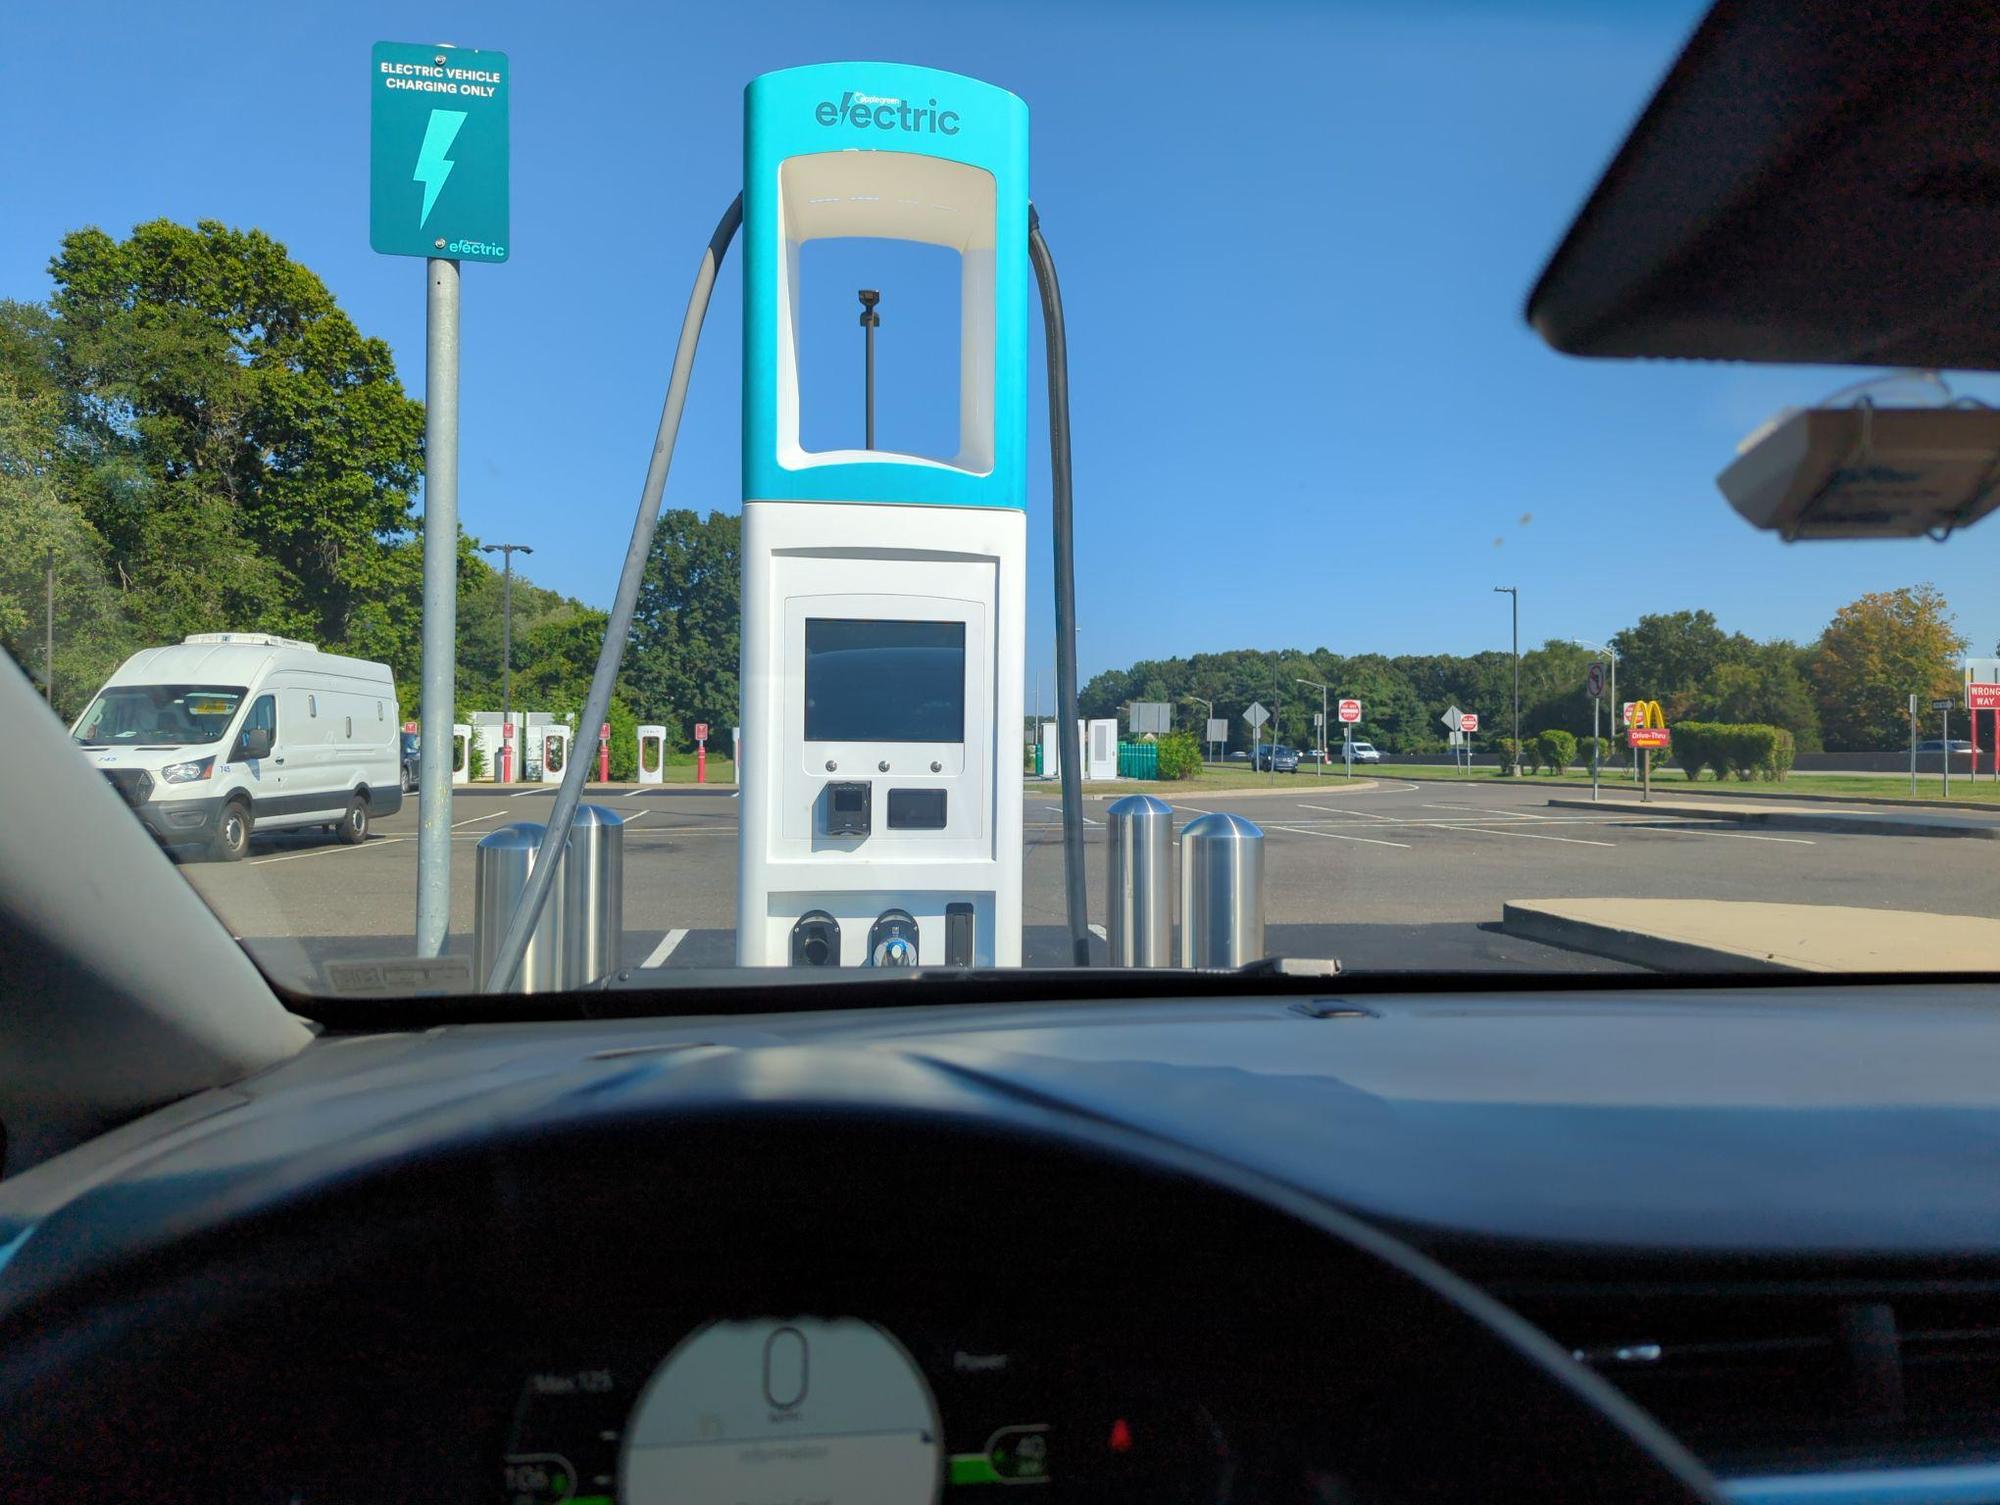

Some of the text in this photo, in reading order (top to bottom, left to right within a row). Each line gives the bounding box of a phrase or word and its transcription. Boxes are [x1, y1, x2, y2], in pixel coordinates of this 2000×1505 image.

[381, 62, 501, 83] ELECTRIC VEHICLE
[385, 78, 495, 97] CHARGING ONLY
[815, 92, 961, 135] electric
[449, 240, 505, 257] electric
[1971, 687, 2000, 696] WRONG
